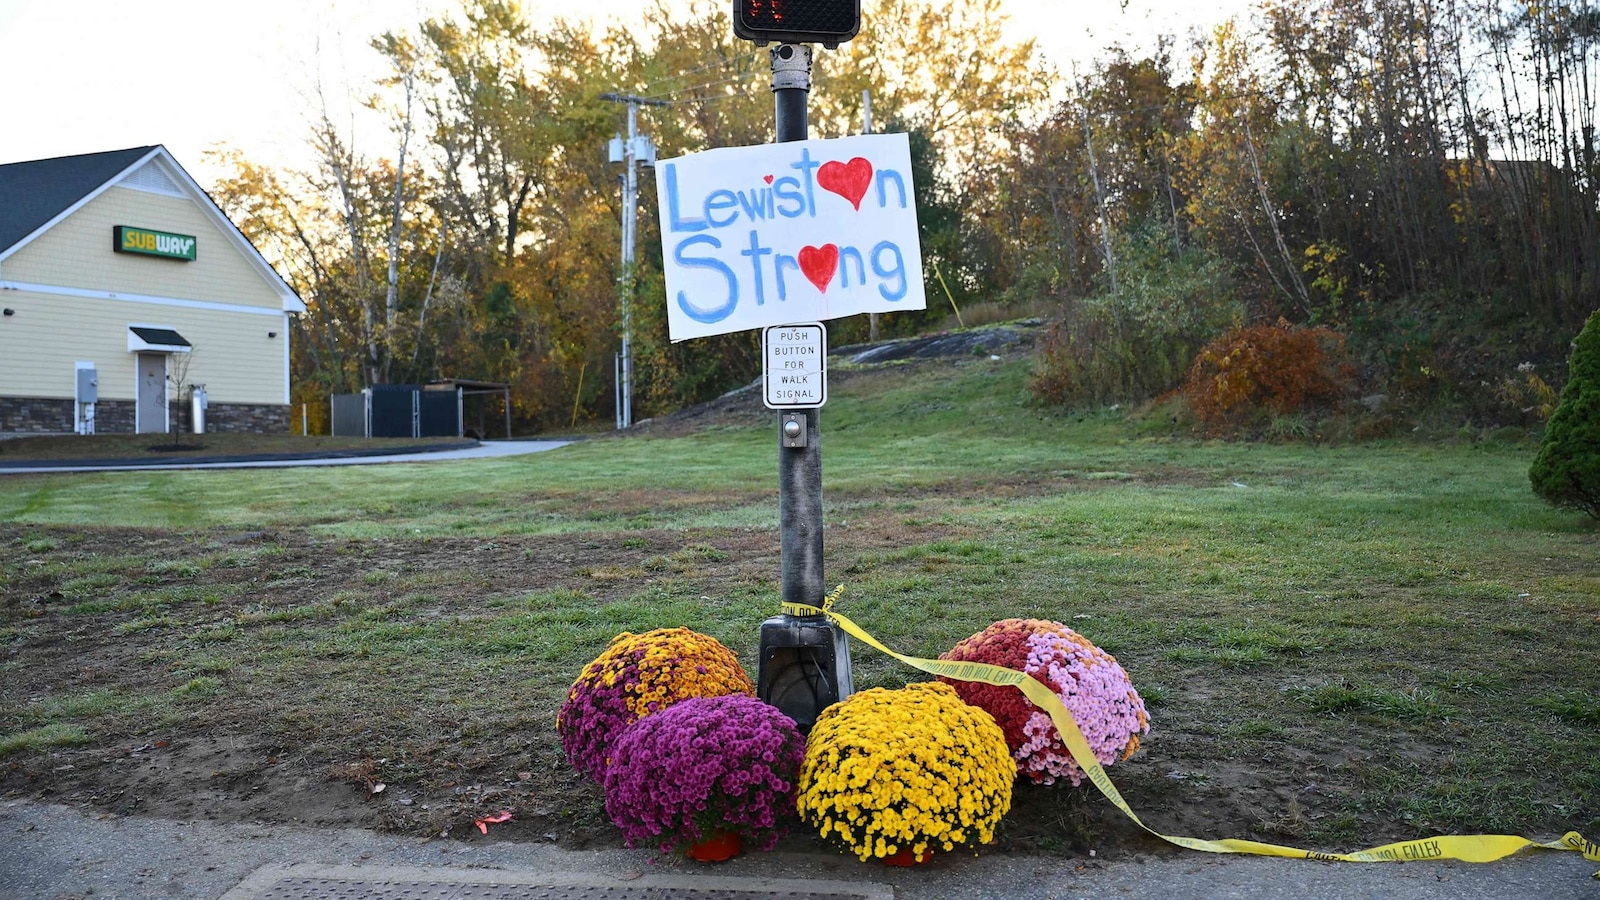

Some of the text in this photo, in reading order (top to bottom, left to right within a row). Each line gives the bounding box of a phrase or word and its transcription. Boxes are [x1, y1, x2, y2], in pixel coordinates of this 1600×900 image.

[124, 230, 195, 255] SUBWAY
[780, 332, 808, 341] PUSH
[774, 346, 814, 356] BUTTON
[784, 361, 804, 369] FOR
[781, 375, 808, 384] WALK
[776, 390, 814, 399] SIGNAL
